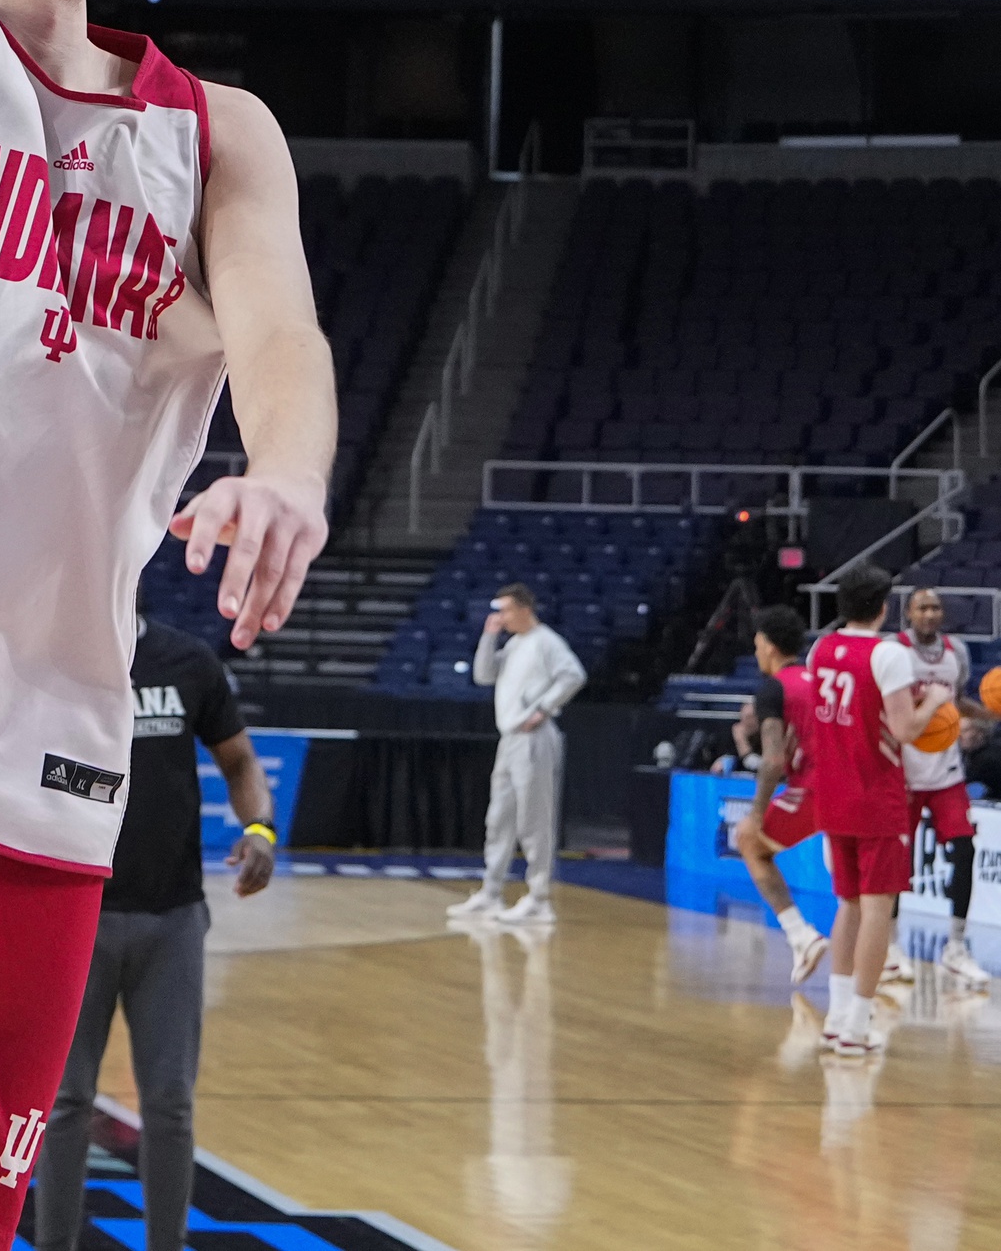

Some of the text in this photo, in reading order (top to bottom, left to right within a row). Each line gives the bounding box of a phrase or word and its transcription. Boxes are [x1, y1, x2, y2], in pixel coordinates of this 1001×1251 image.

[53, 158, 95, 171] adidas
[815, 667, 856, 727] 32
[76, 778, 87, 790] XL
